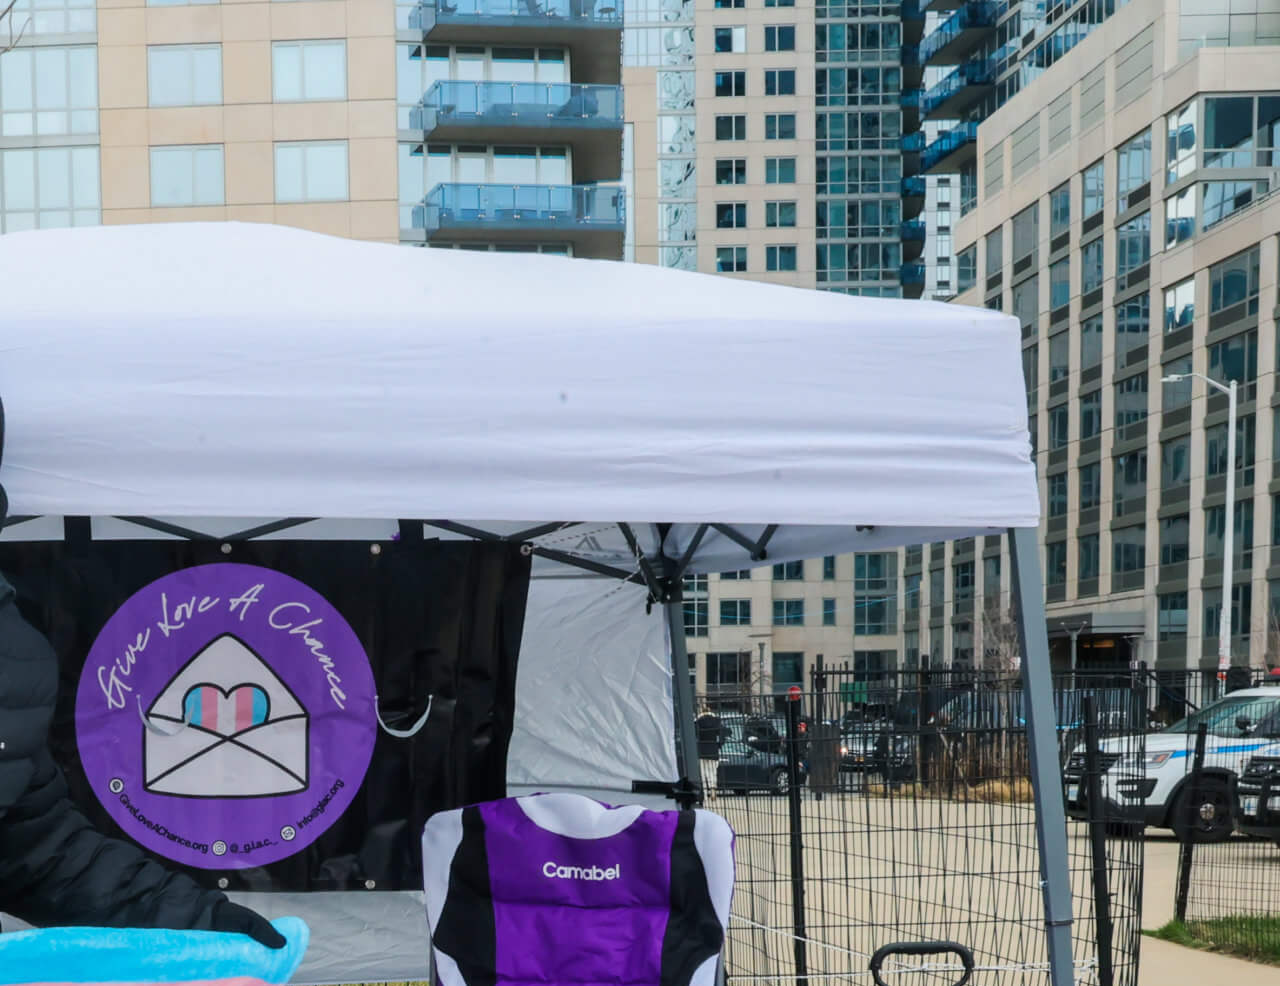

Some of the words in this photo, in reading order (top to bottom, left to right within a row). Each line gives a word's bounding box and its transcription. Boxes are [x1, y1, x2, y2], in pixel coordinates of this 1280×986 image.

[98, 628, 150, 709] Give
[157, 592, 219, 637] Love
[229, 583, 264, 621] A
[269, 602, 346, 710] Chance
[542, 861, 620, 881] Camabel
